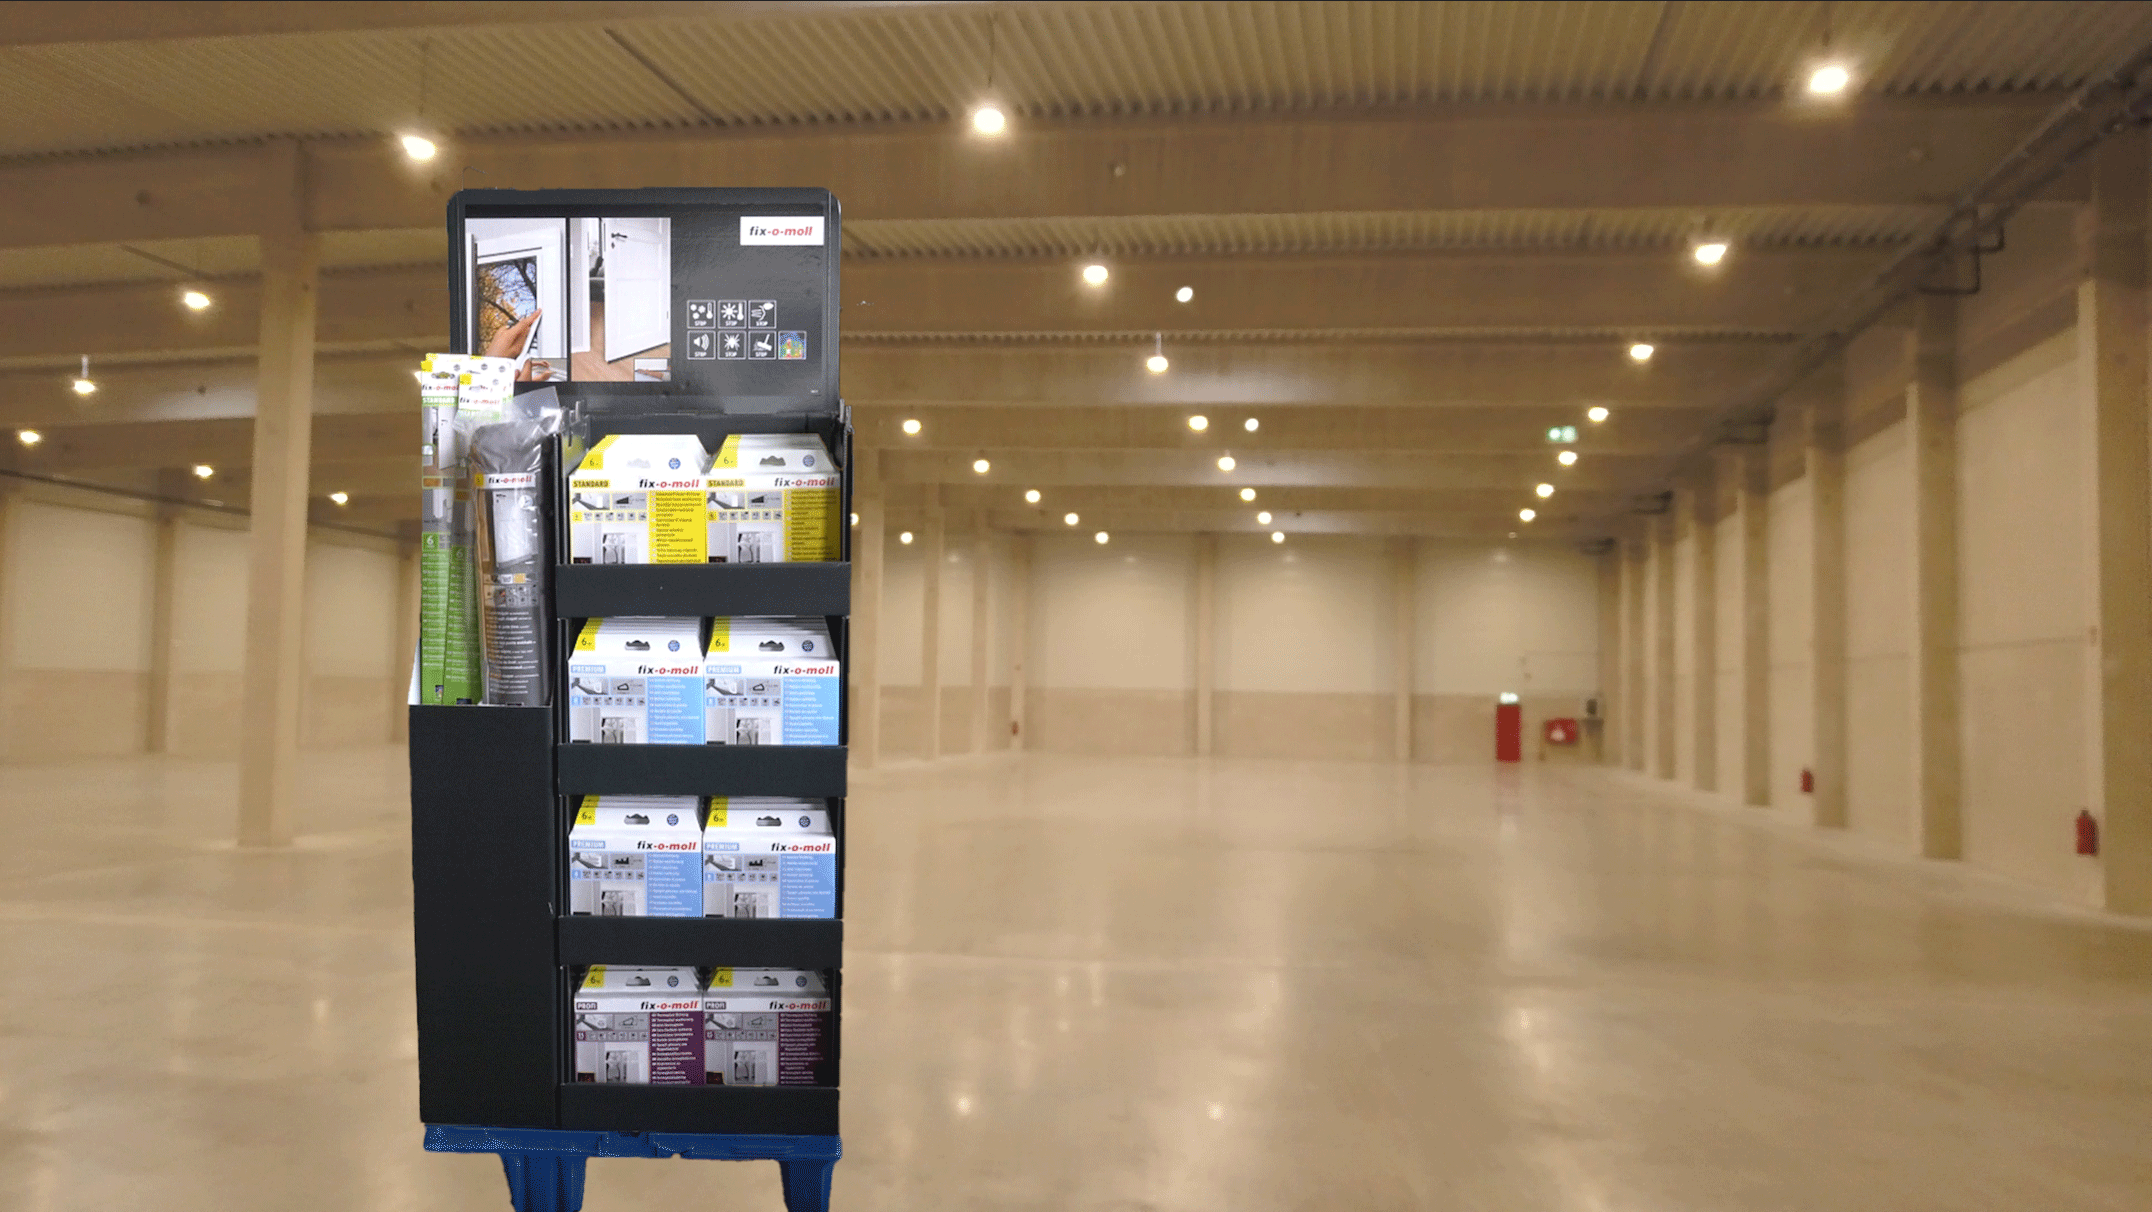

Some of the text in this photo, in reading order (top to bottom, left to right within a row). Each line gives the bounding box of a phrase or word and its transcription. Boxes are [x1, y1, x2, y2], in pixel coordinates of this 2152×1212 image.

[749, 226, 813, 236] fix-o-moll
[573, 480, 609, 488] STANDARD
[639, 479, 700, 488] fix-o-moll
[708, 479, 744, 487] STANDARD
[774, 477, 835, 487] fix-o-moll
[638, 665, 699, 674] fix-o-moll
[773, 665, 834, 675] fix-o-moll
[637, 841, 697, 850] fix-o-moll
[771, 843, 831, 852] fix-o-moll
[640, 1000, 699, 1010] fix-o-moll
[769, 1001, 827, 1010] fix-o-moll
